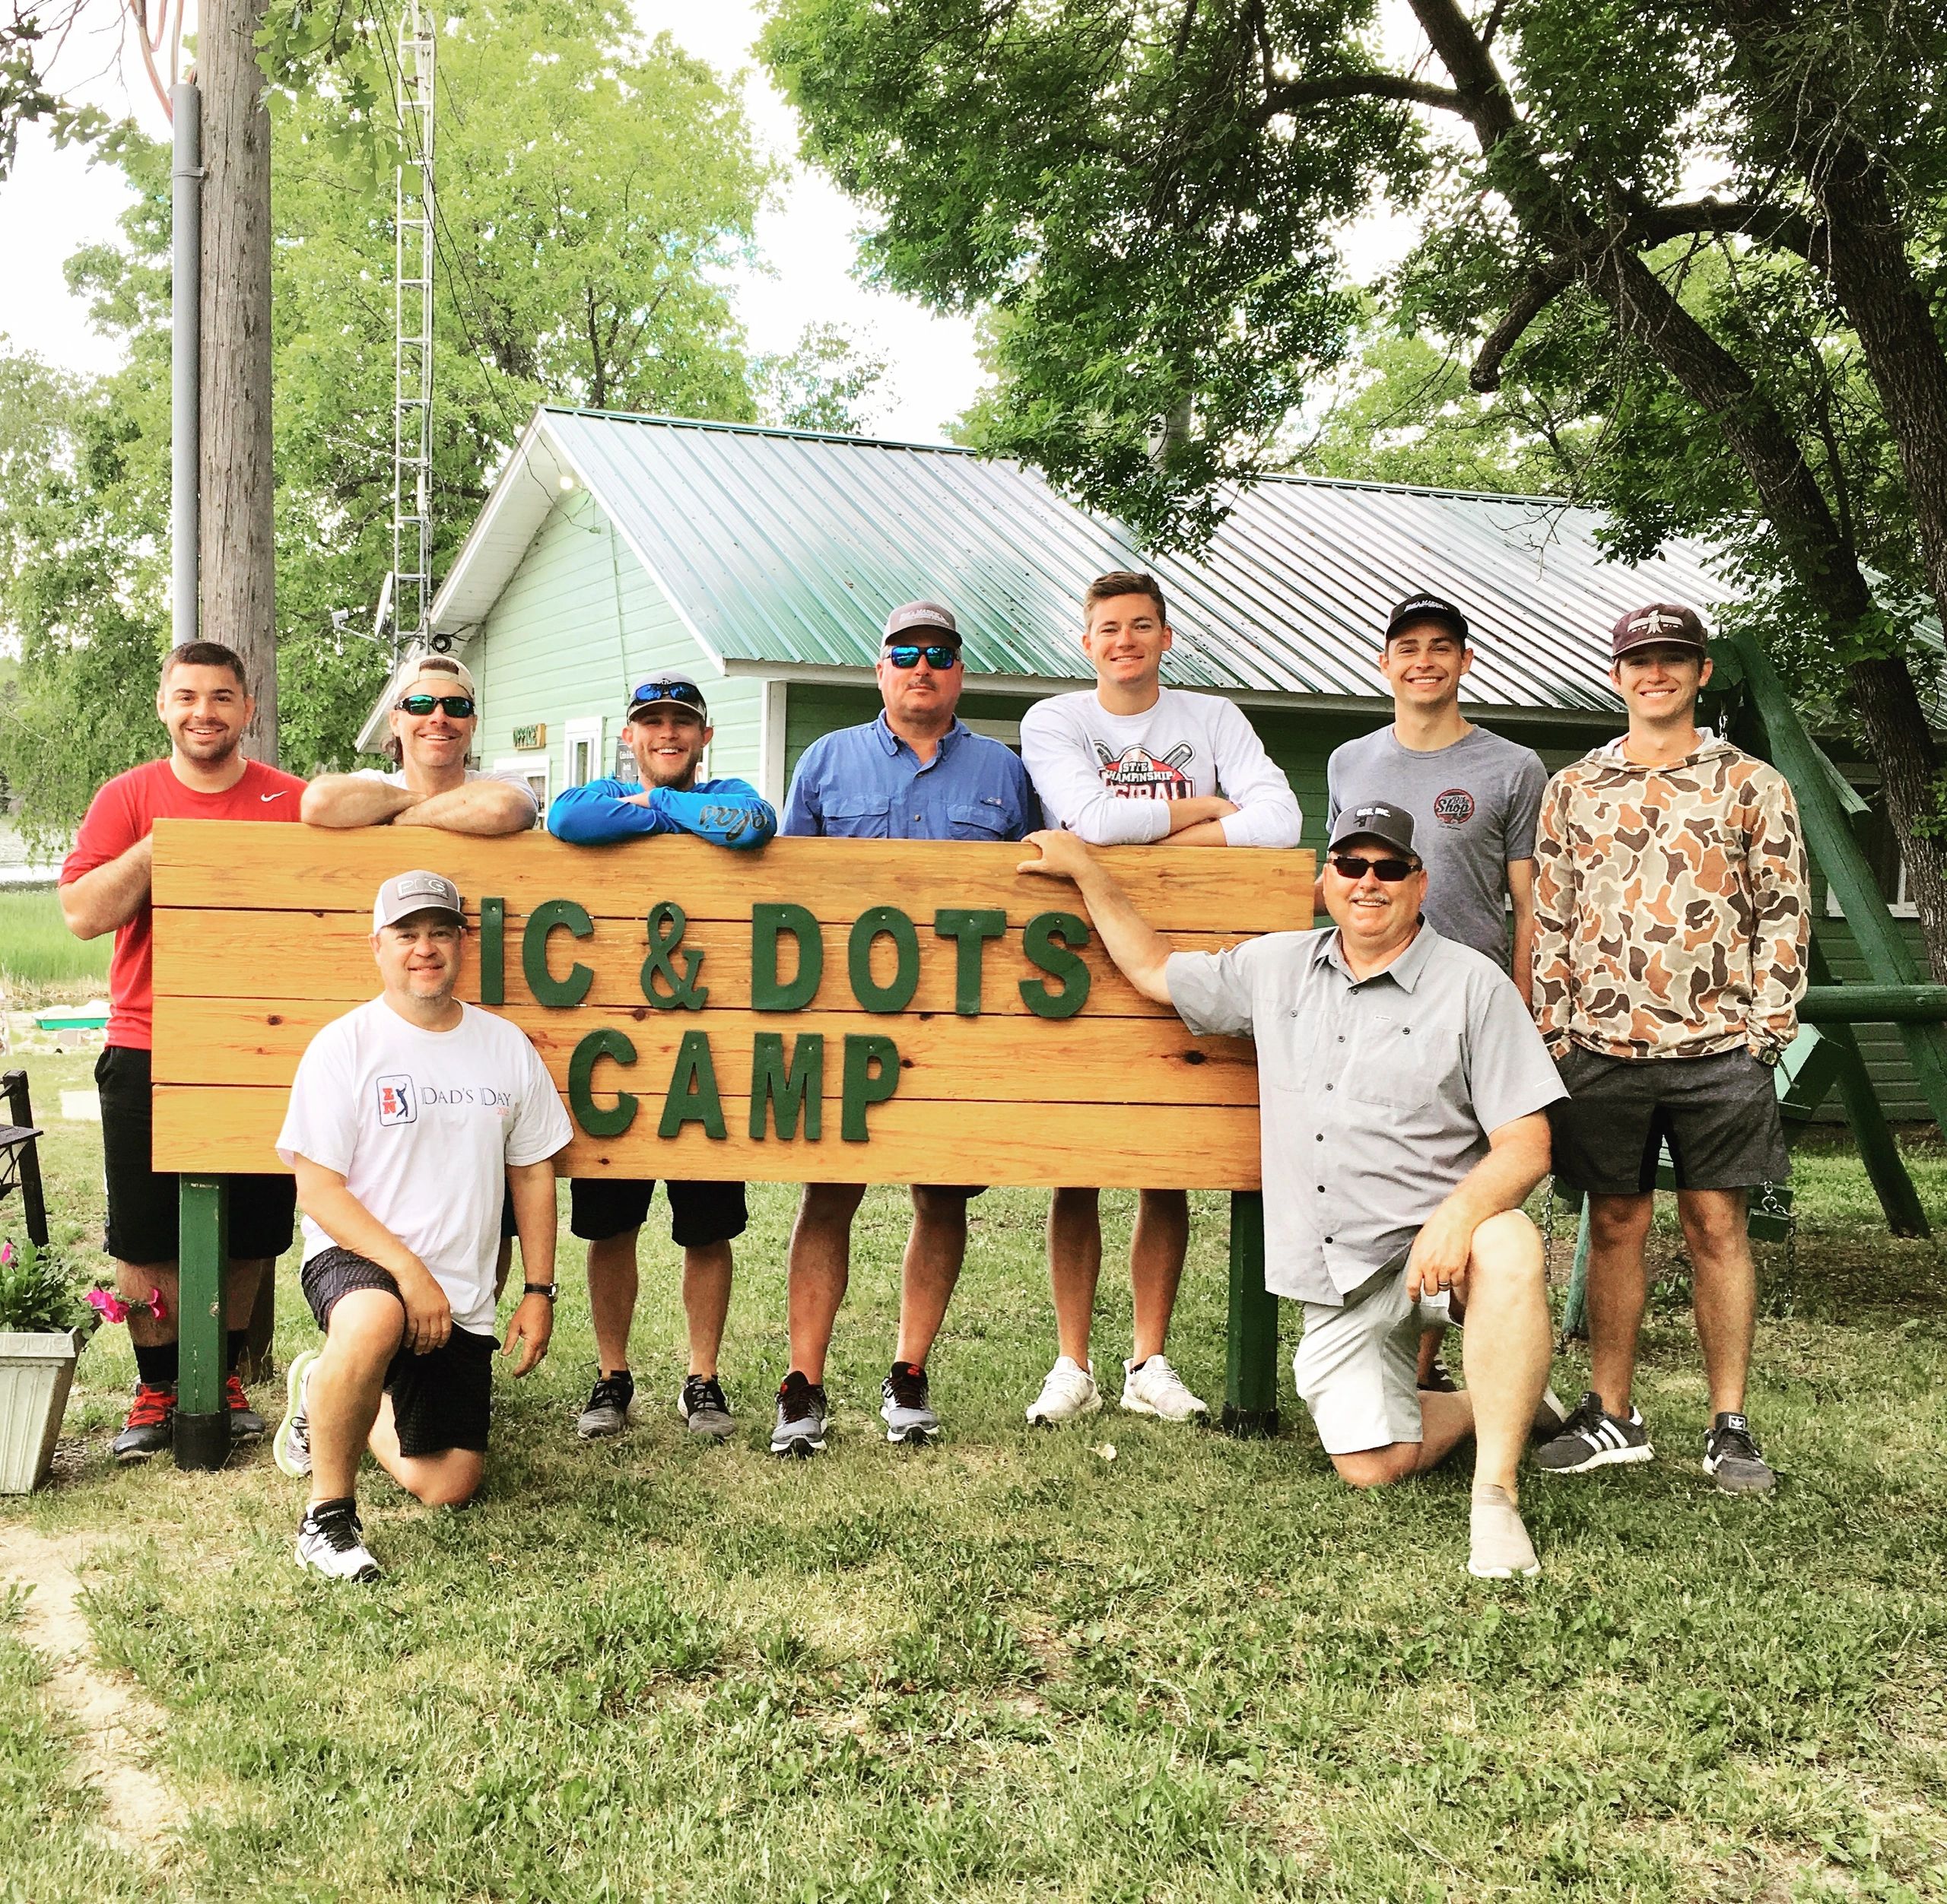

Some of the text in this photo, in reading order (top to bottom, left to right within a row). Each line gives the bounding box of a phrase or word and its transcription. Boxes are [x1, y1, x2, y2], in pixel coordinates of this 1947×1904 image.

[1436, 798, 1471, 816] Shop
[459, 896, 1090, 1017] IC & DOTS
[569, 1030, 900, 1141] CAMP
